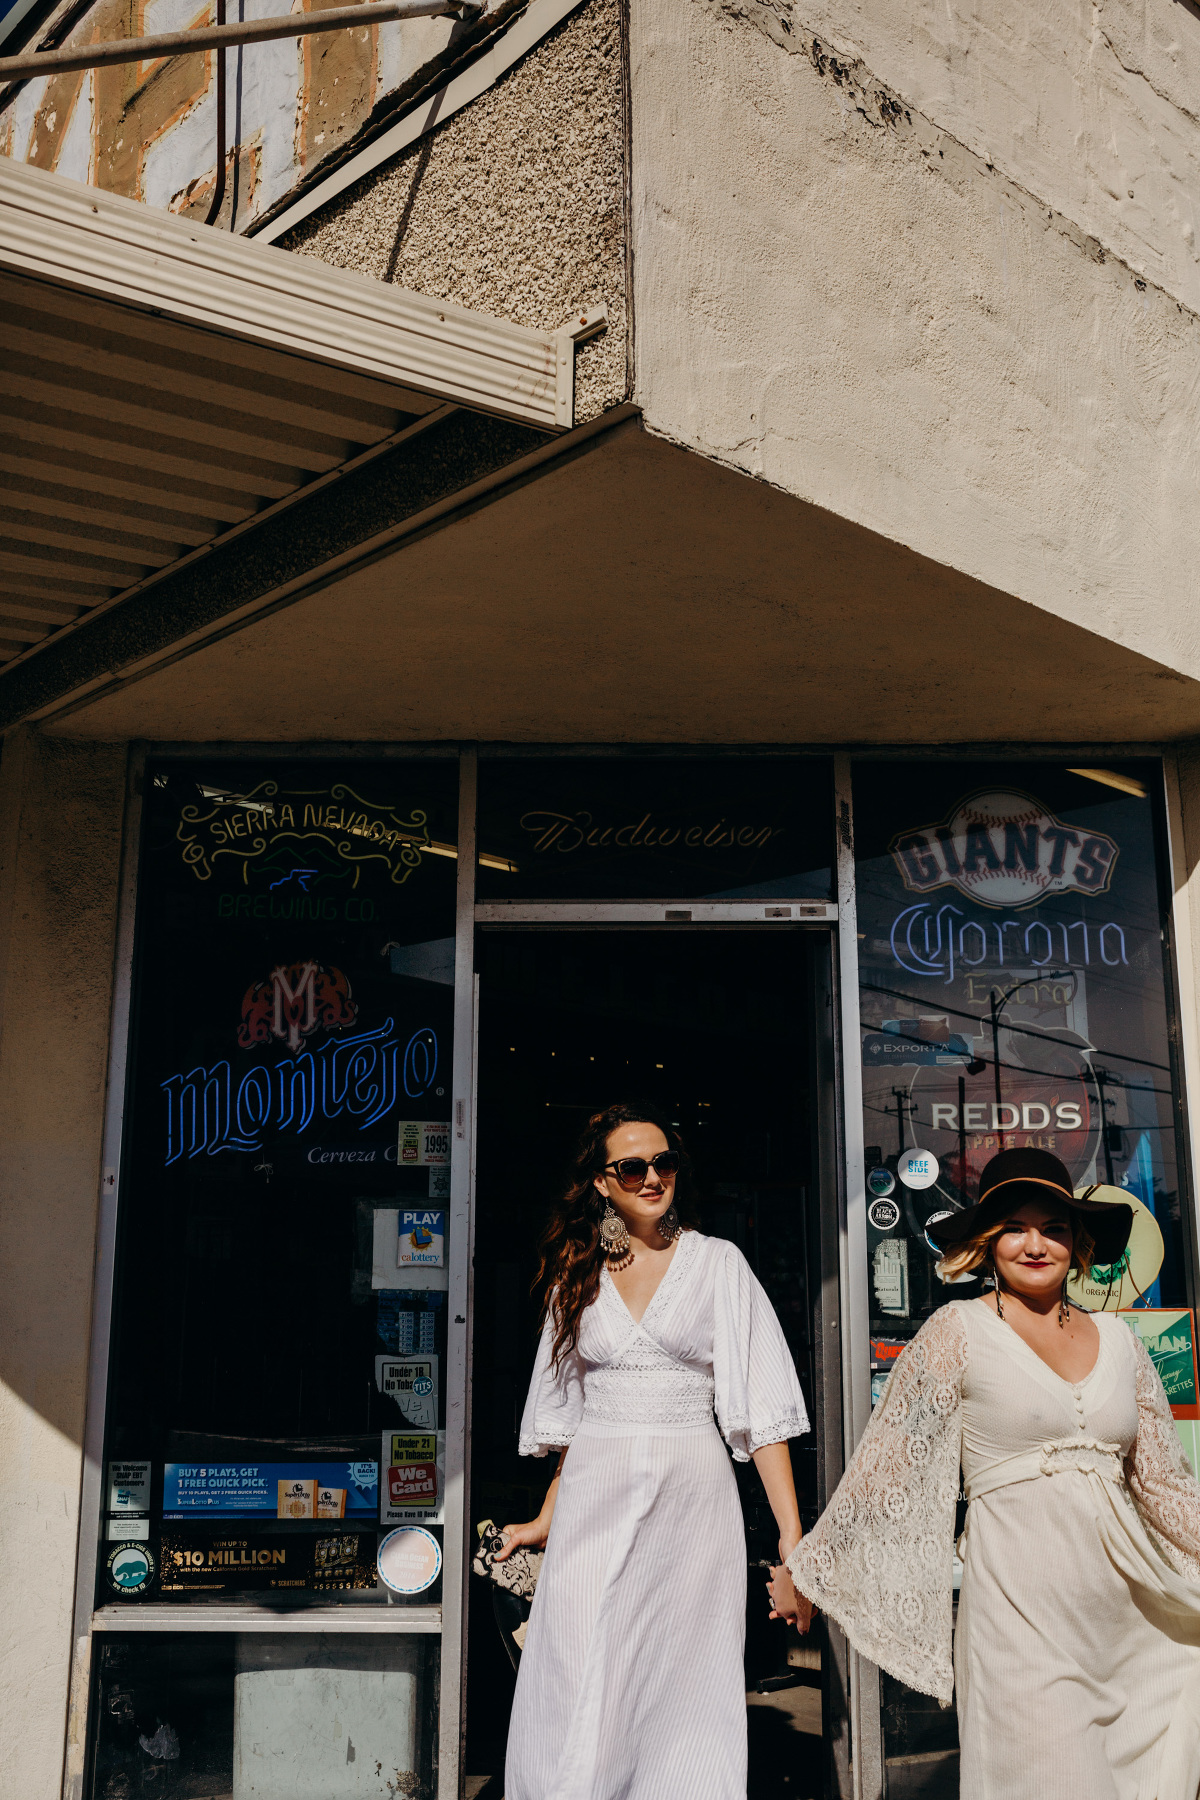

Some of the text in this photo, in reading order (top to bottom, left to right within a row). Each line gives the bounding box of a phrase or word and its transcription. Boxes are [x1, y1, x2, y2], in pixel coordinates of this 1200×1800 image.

[209, 803, 399, 851] SIERRA NEVADA
[519, 810, 785, 852] Budweiser
[895, 821, 1115, 888] GIANTS
[217, 894, 337, 921] BREWING
[890, 903, 1129, 985] Corona
[964, 972, 1070, 1005] Extra
[883, 1043, 936, 1053] EXPORT
[160, 1017, 439, 1166] Montejo
[425, 1135, 448, 1153] 1995
[1024, 1136, 1056, 1149] ALE
[307, 1146, 397, 1164] Cerveza C
[908, 1160, 928, 1168] REEF
[404, 1212, 440, 1224] PLAY
[401, 1252, 440, 1264] calottery
[875, 1342, 906, 1362] QUES
[389, 1366, 424, 1378] Under 18
[385, 1379, 414, 1390] No Toba
[414, 1382, 431, 1392] TITS
[1164, 1378, 1194, 1396] ARETTES
[398, 1438, 430, 1449] Under 21
[394, 1450, 434, 1460] No Tobacco
[178, 1468, 258, 1478] BUY 5 PLAYS, GET
[397, 1466, 427, 1482] We
[178, 1479, 183, 1487] 1
[184, 1479, 206, 1487] FREE
[208, 1479, 240, 1487] QUICK
[391, 1478, 434, 1495] Card
[173, 1550, 286, 1566] $10 MILLION
